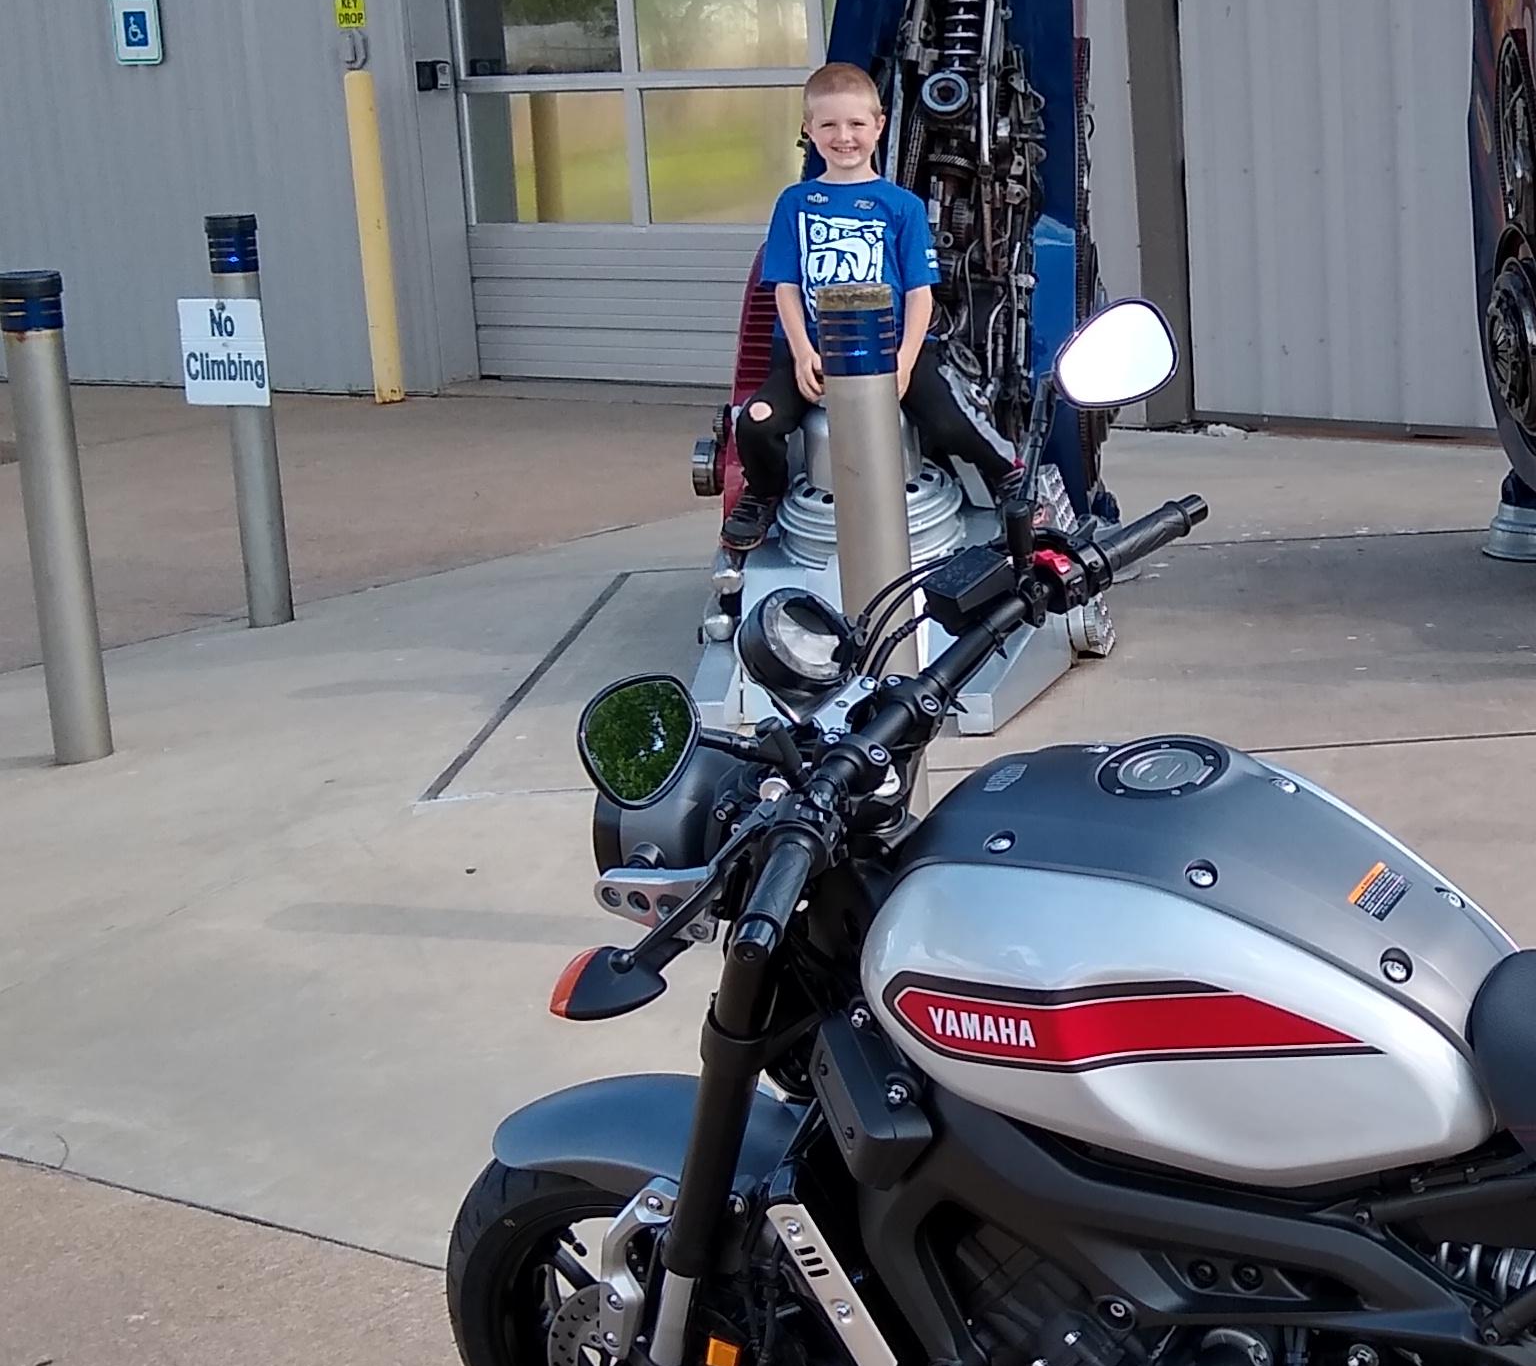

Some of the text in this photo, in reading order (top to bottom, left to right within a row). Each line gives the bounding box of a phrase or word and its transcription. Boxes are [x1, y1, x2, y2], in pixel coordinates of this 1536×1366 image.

[338, 12, 364, 25] DROP
[209, 308, 235, 337] No
[186, 351, 266, 389] Climbing
[927, 1005, 1037, 1049] YAMAHA
